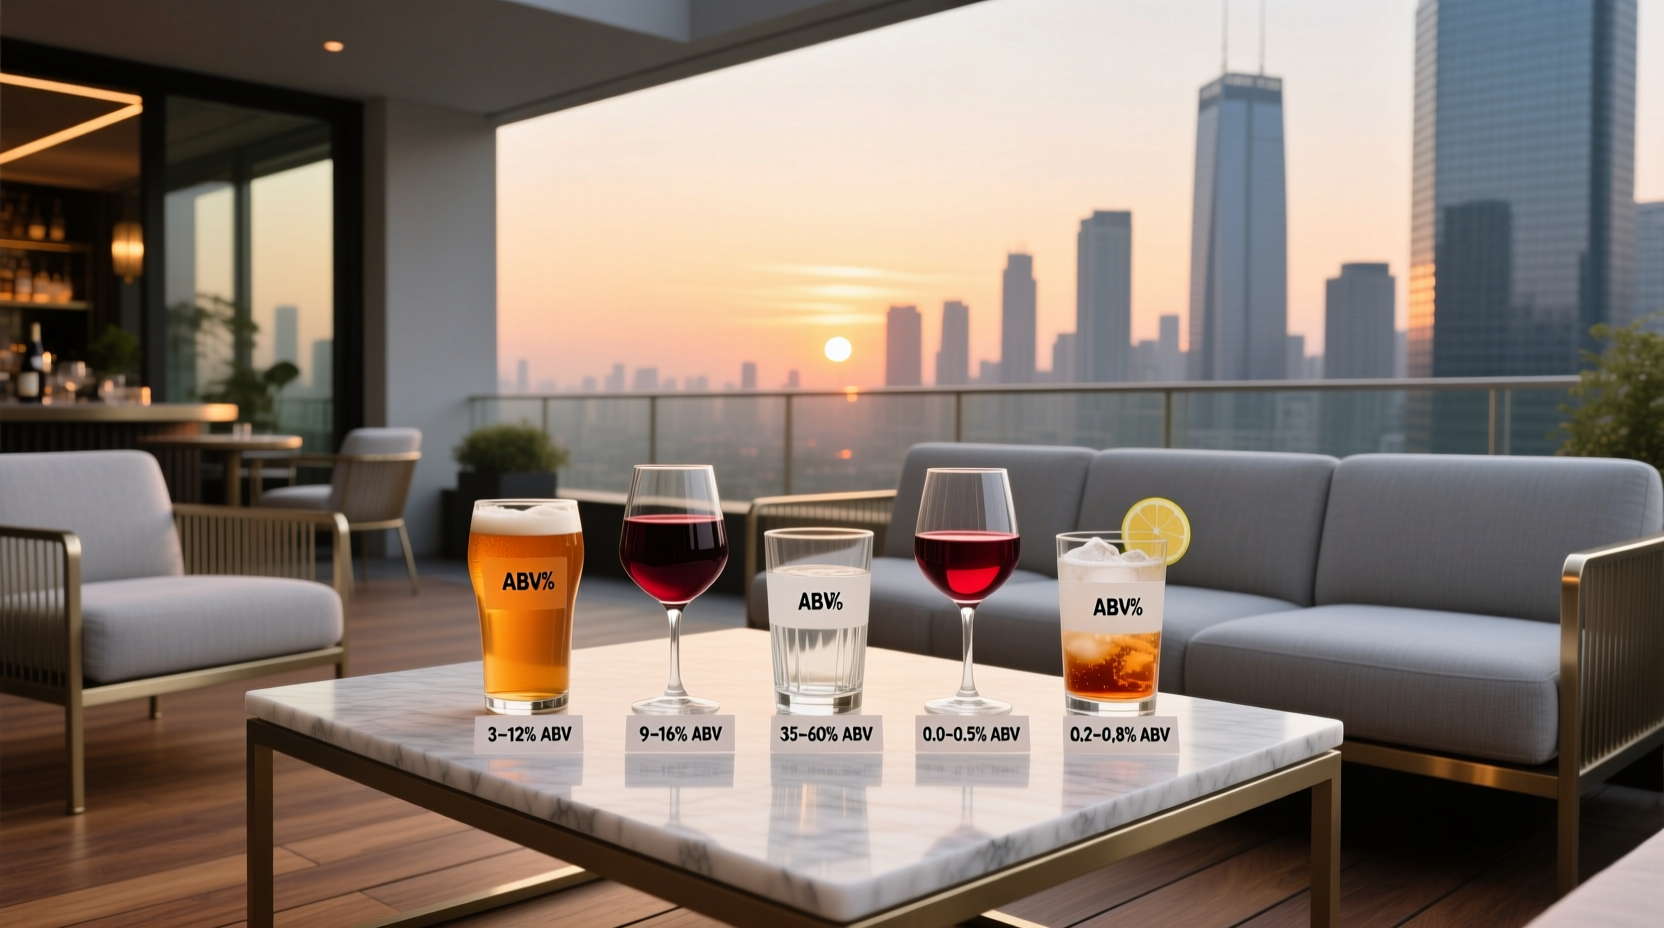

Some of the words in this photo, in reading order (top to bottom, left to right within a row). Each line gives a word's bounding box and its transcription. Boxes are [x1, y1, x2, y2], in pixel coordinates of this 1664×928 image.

[502, 570, 556, 591] ABV%
[798, 591, 844, 611] ABV%
[1093, 597, 1144, 616] ABV%
[540, 726, 572, 742] ABV
[691, 726, 723, 741] ABV
[842, 725, 874, 742] ABV
[990, 726, 1021, 742] ABV
[1139, 726, 1171, 743] ABV
